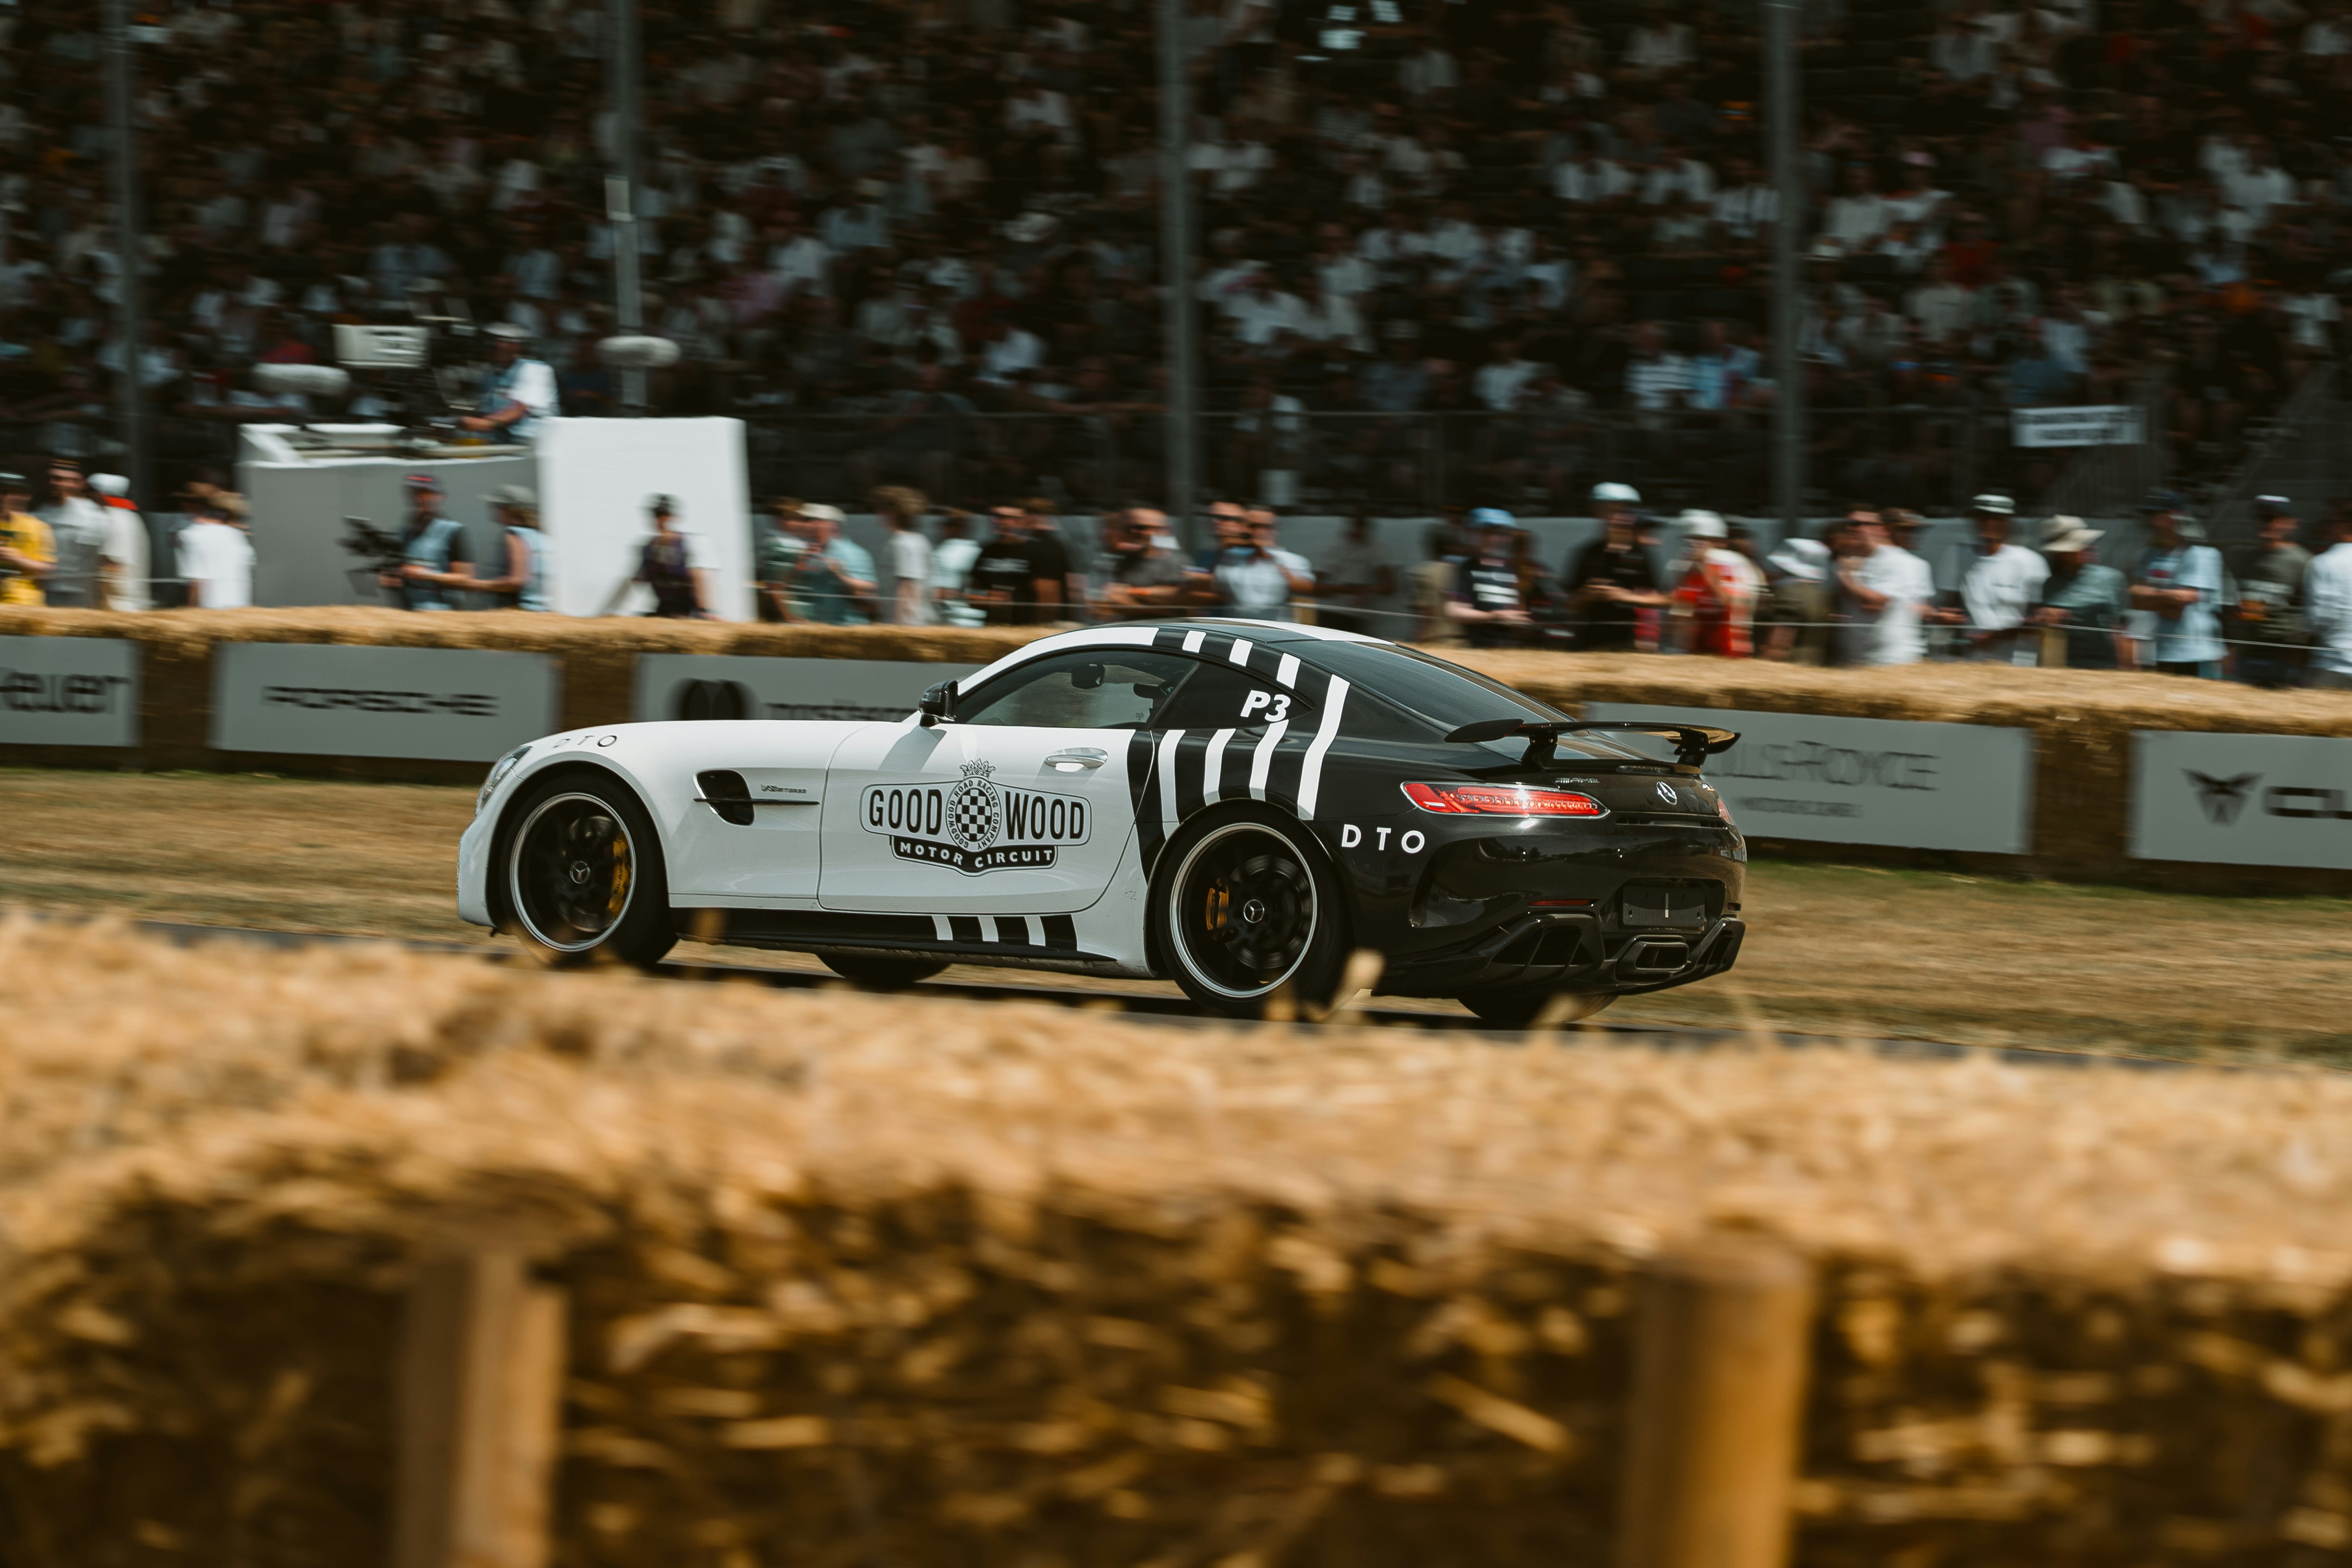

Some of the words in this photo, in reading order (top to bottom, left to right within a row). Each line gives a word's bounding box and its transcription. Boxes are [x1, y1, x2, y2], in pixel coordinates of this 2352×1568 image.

[1240, 690, 1291, 722] P3
[953, 780, 973, 798] ROAD
[977, 780, 998, 808] RACING
[869, 789, 942, 835] GOOD
[1005, 790, 1084, 840] WOOD
[948, 800, 969, 849] GOODWOOD
[977, 812, 1000, 850] COMPANY
[1341, 824, 1425, 853] DTO
[900, 842, 963, 866] MOTOR
[975, 849, 1052, 867] CIRCUIT
